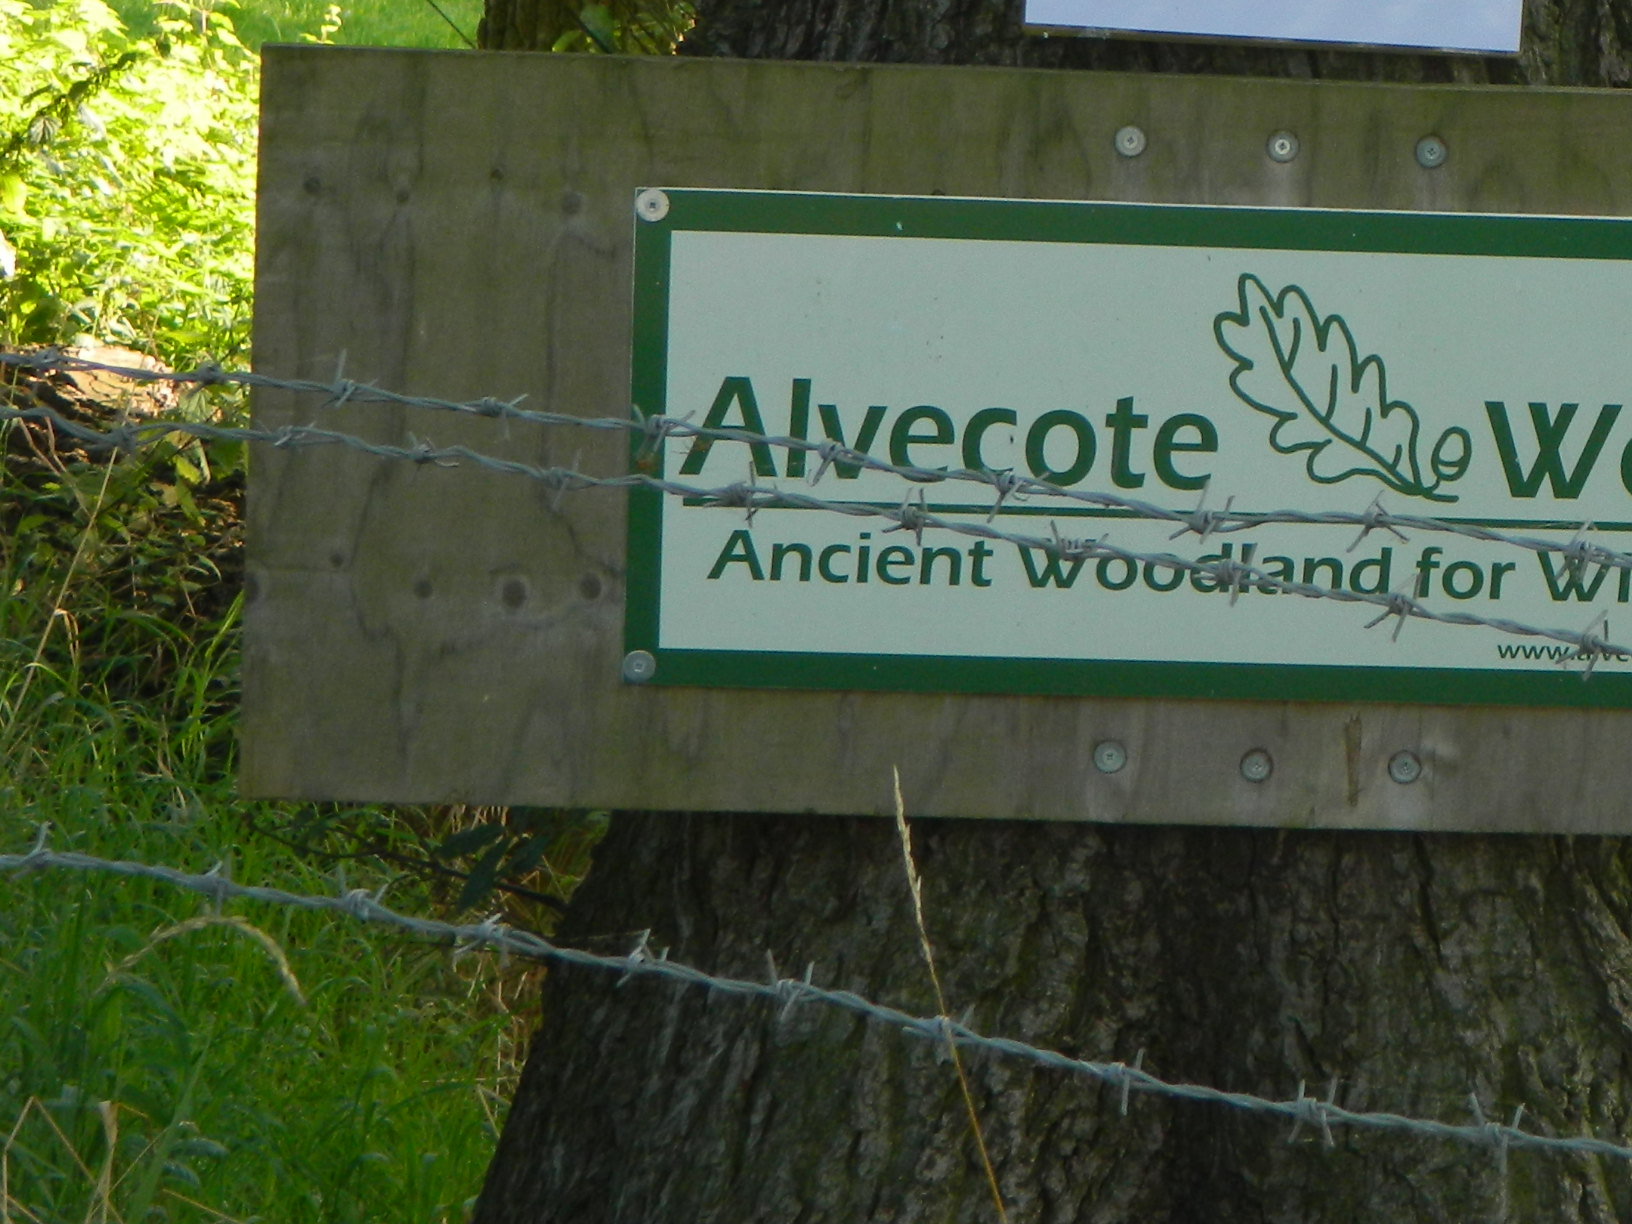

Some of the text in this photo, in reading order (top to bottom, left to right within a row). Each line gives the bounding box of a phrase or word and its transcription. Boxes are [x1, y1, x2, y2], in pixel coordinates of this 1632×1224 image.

[679, 376, 1219, 491] Alvecote
[707, 529, 993, 588] Ancient
[1018, 538, 1394, 600] Woodland
[1415, 546, 1515, 600] for
